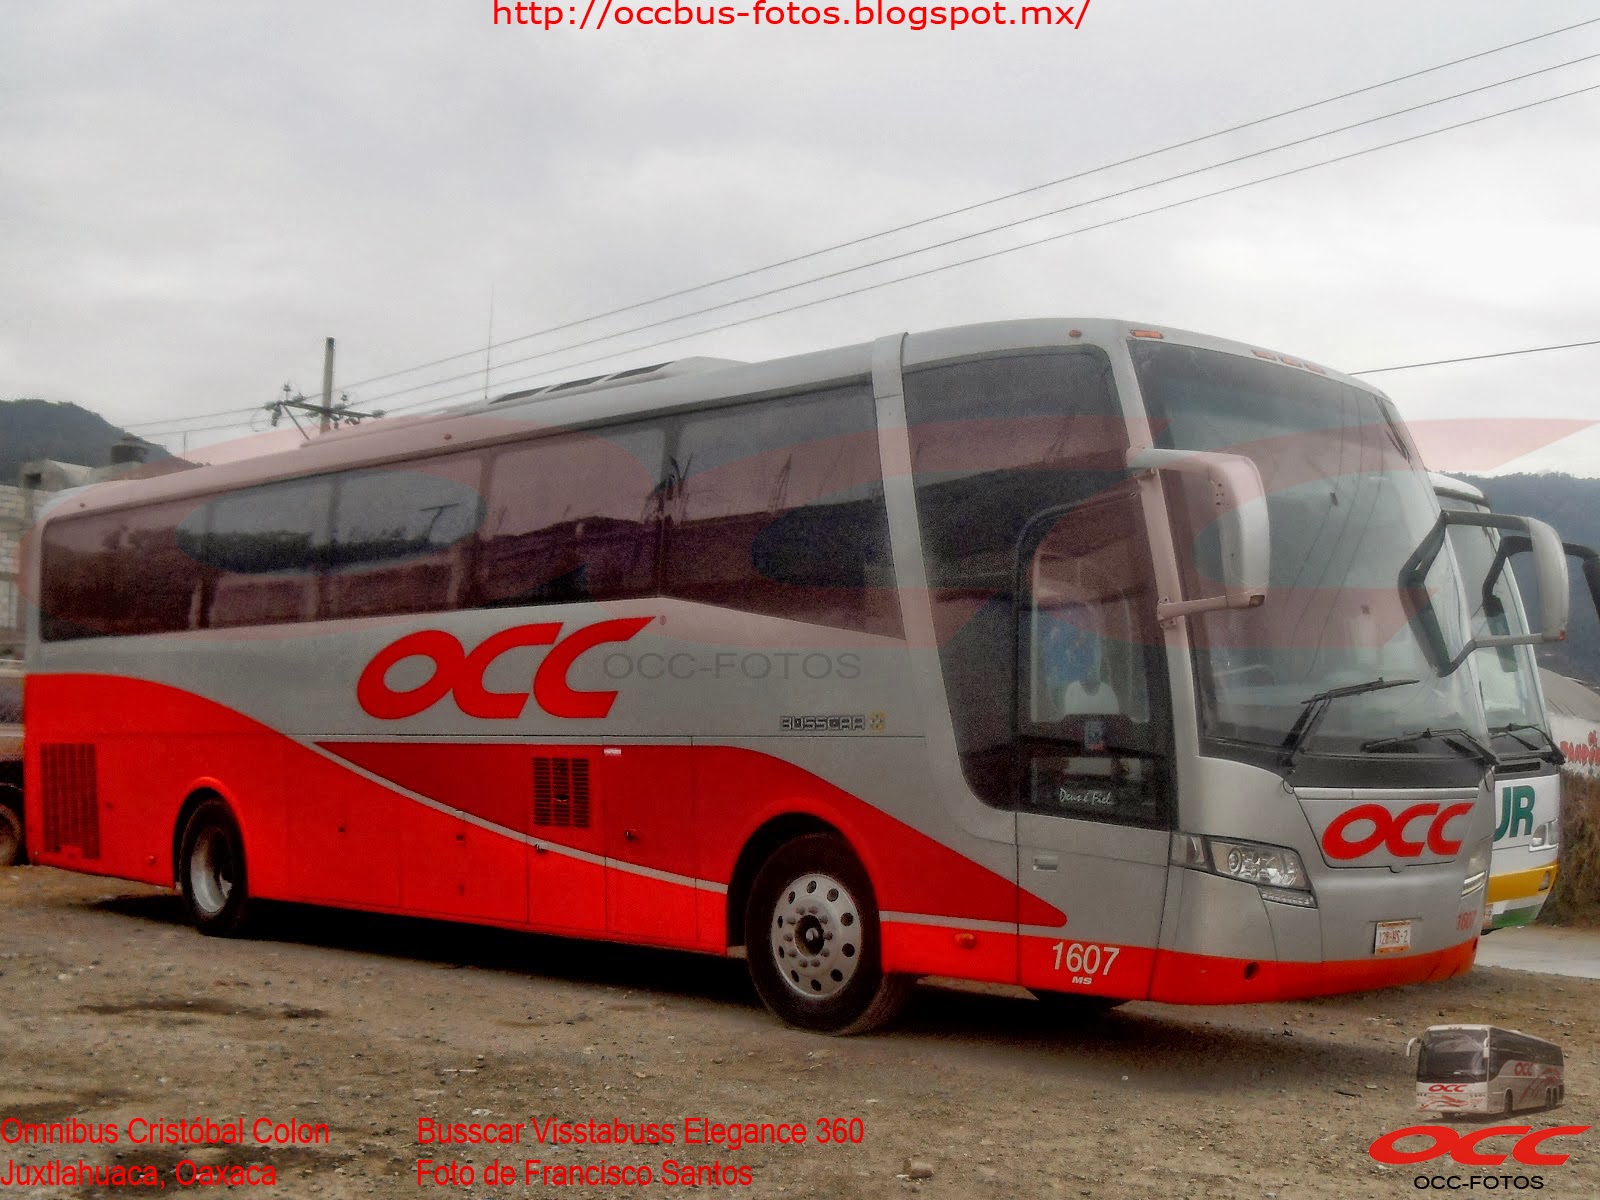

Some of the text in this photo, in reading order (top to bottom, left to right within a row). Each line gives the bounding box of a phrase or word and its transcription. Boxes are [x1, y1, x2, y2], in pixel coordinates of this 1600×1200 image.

[357, 616, 656, 720] OCC
[1321, 803, 1474, 860] OCC
[1052, 941, 1120, 976] 1607
[1071, 976, 1093, 985] MS
